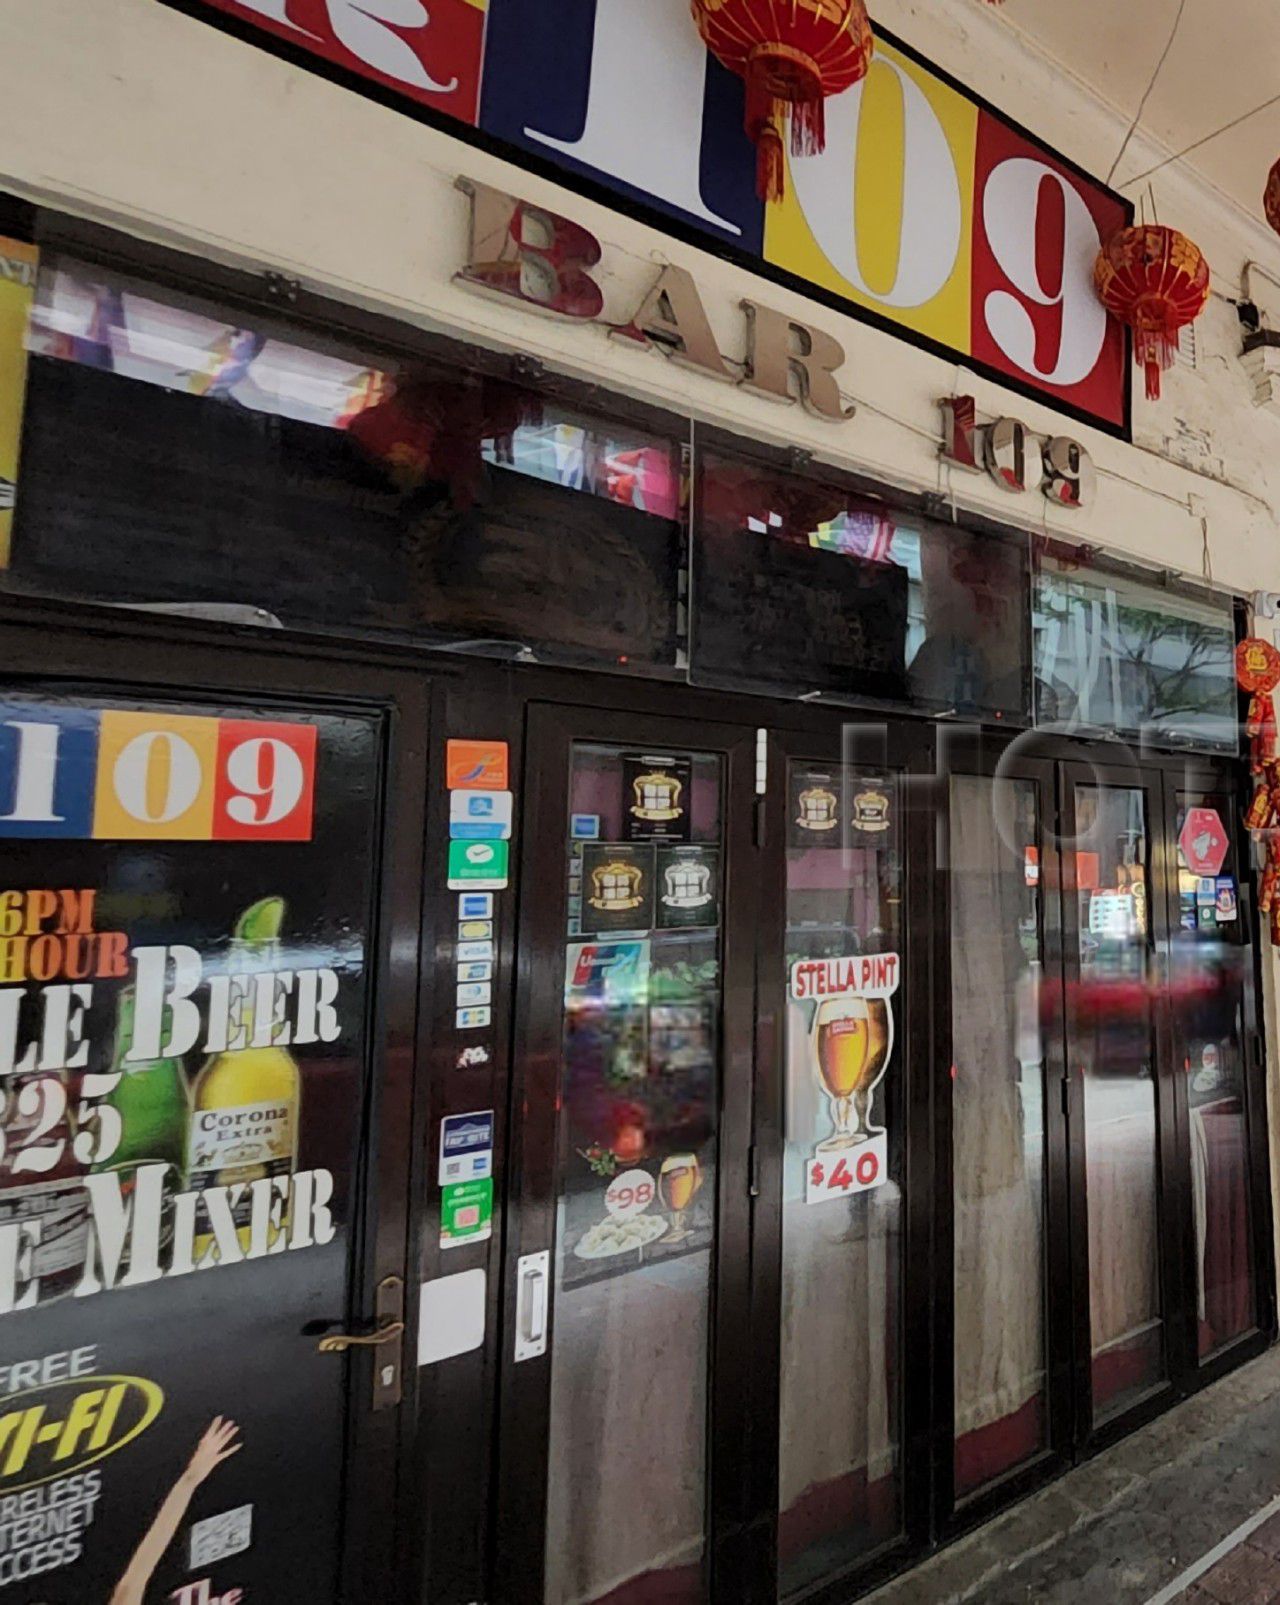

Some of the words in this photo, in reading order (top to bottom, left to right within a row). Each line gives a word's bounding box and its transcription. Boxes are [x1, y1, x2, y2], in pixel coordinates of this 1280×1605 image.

[452, 174, 856, 421] BAR
[937, 394, 1093, 508] 109
[0, 720, 304, 826] 109
[125, 944, 342, 1061] BEER
[797, 960, 856, 997] STELLA
[861, 956, 896, 990] PINT
[0, 1072, 122, 1173] 25
[200, 1106, 288, 1132] Corona
[216, 1124, 273, 1142] Extra
[608, 1183, 652, 1209] $98
[811, 1152, 879, 1191] $40
[74, 1163, 336, 1297] MIXER
